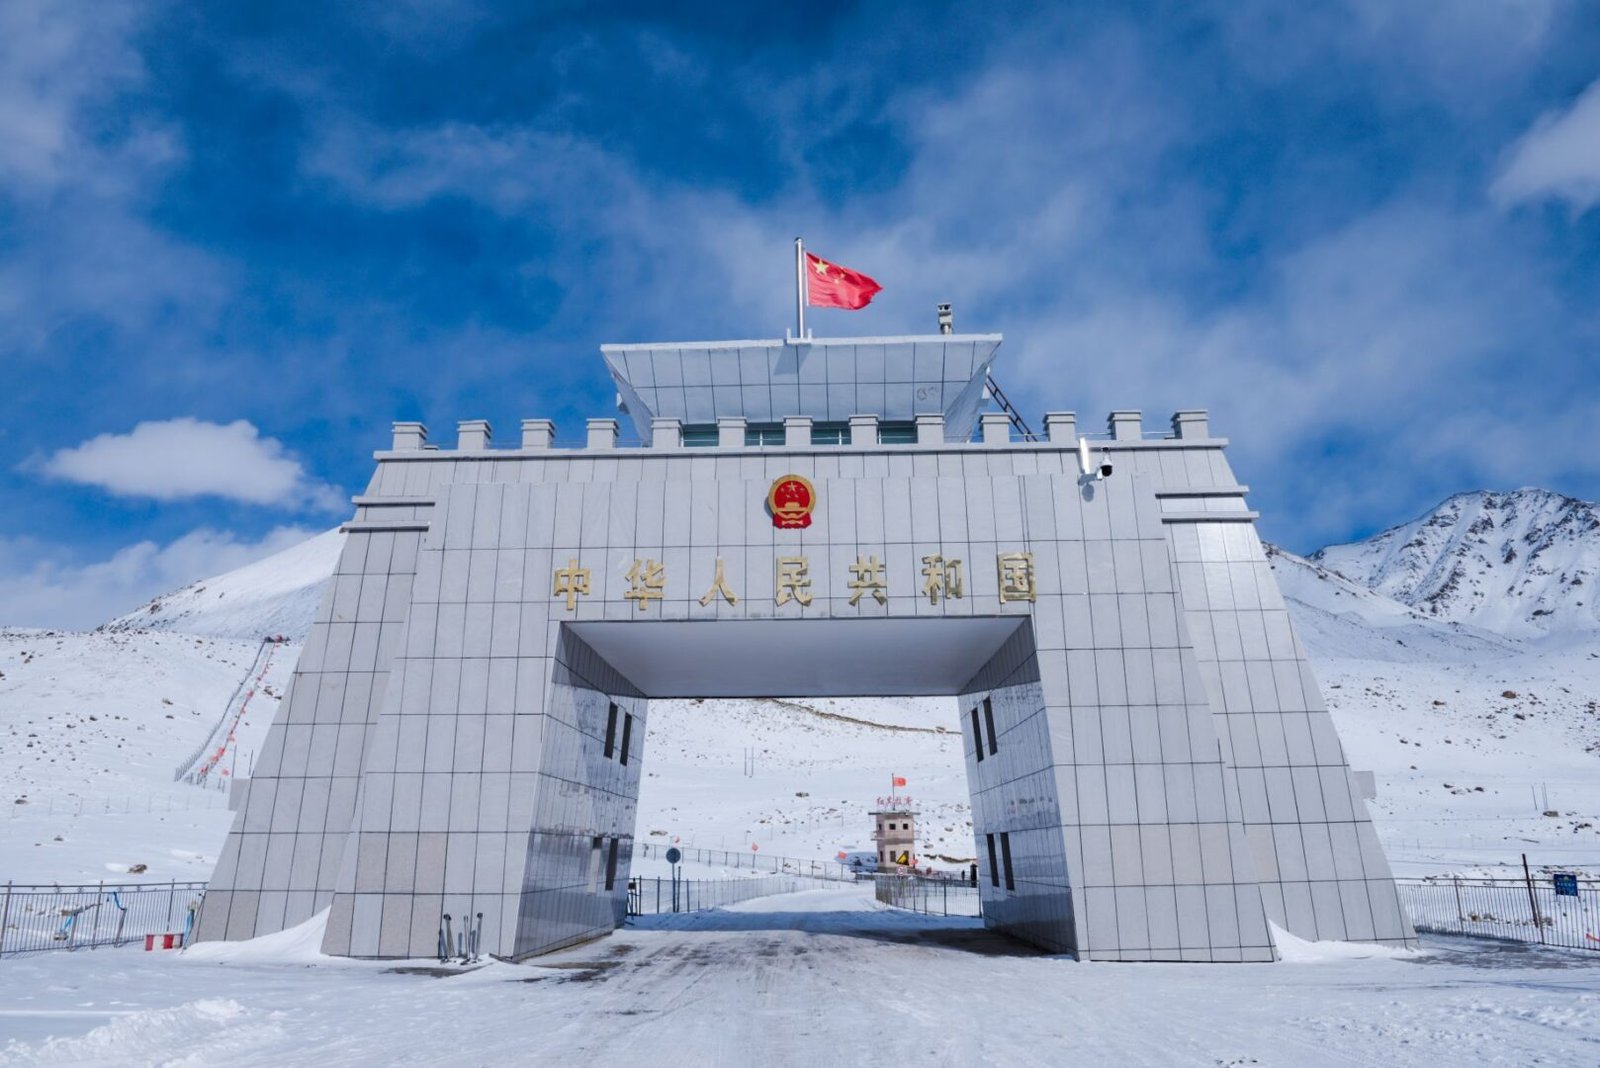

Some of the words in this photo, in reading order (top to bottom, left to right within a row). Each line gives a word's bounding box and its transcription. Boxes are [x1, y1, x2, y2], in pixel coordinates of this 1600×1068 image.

[553, 552, 1037, 611] 中华人民共和国
